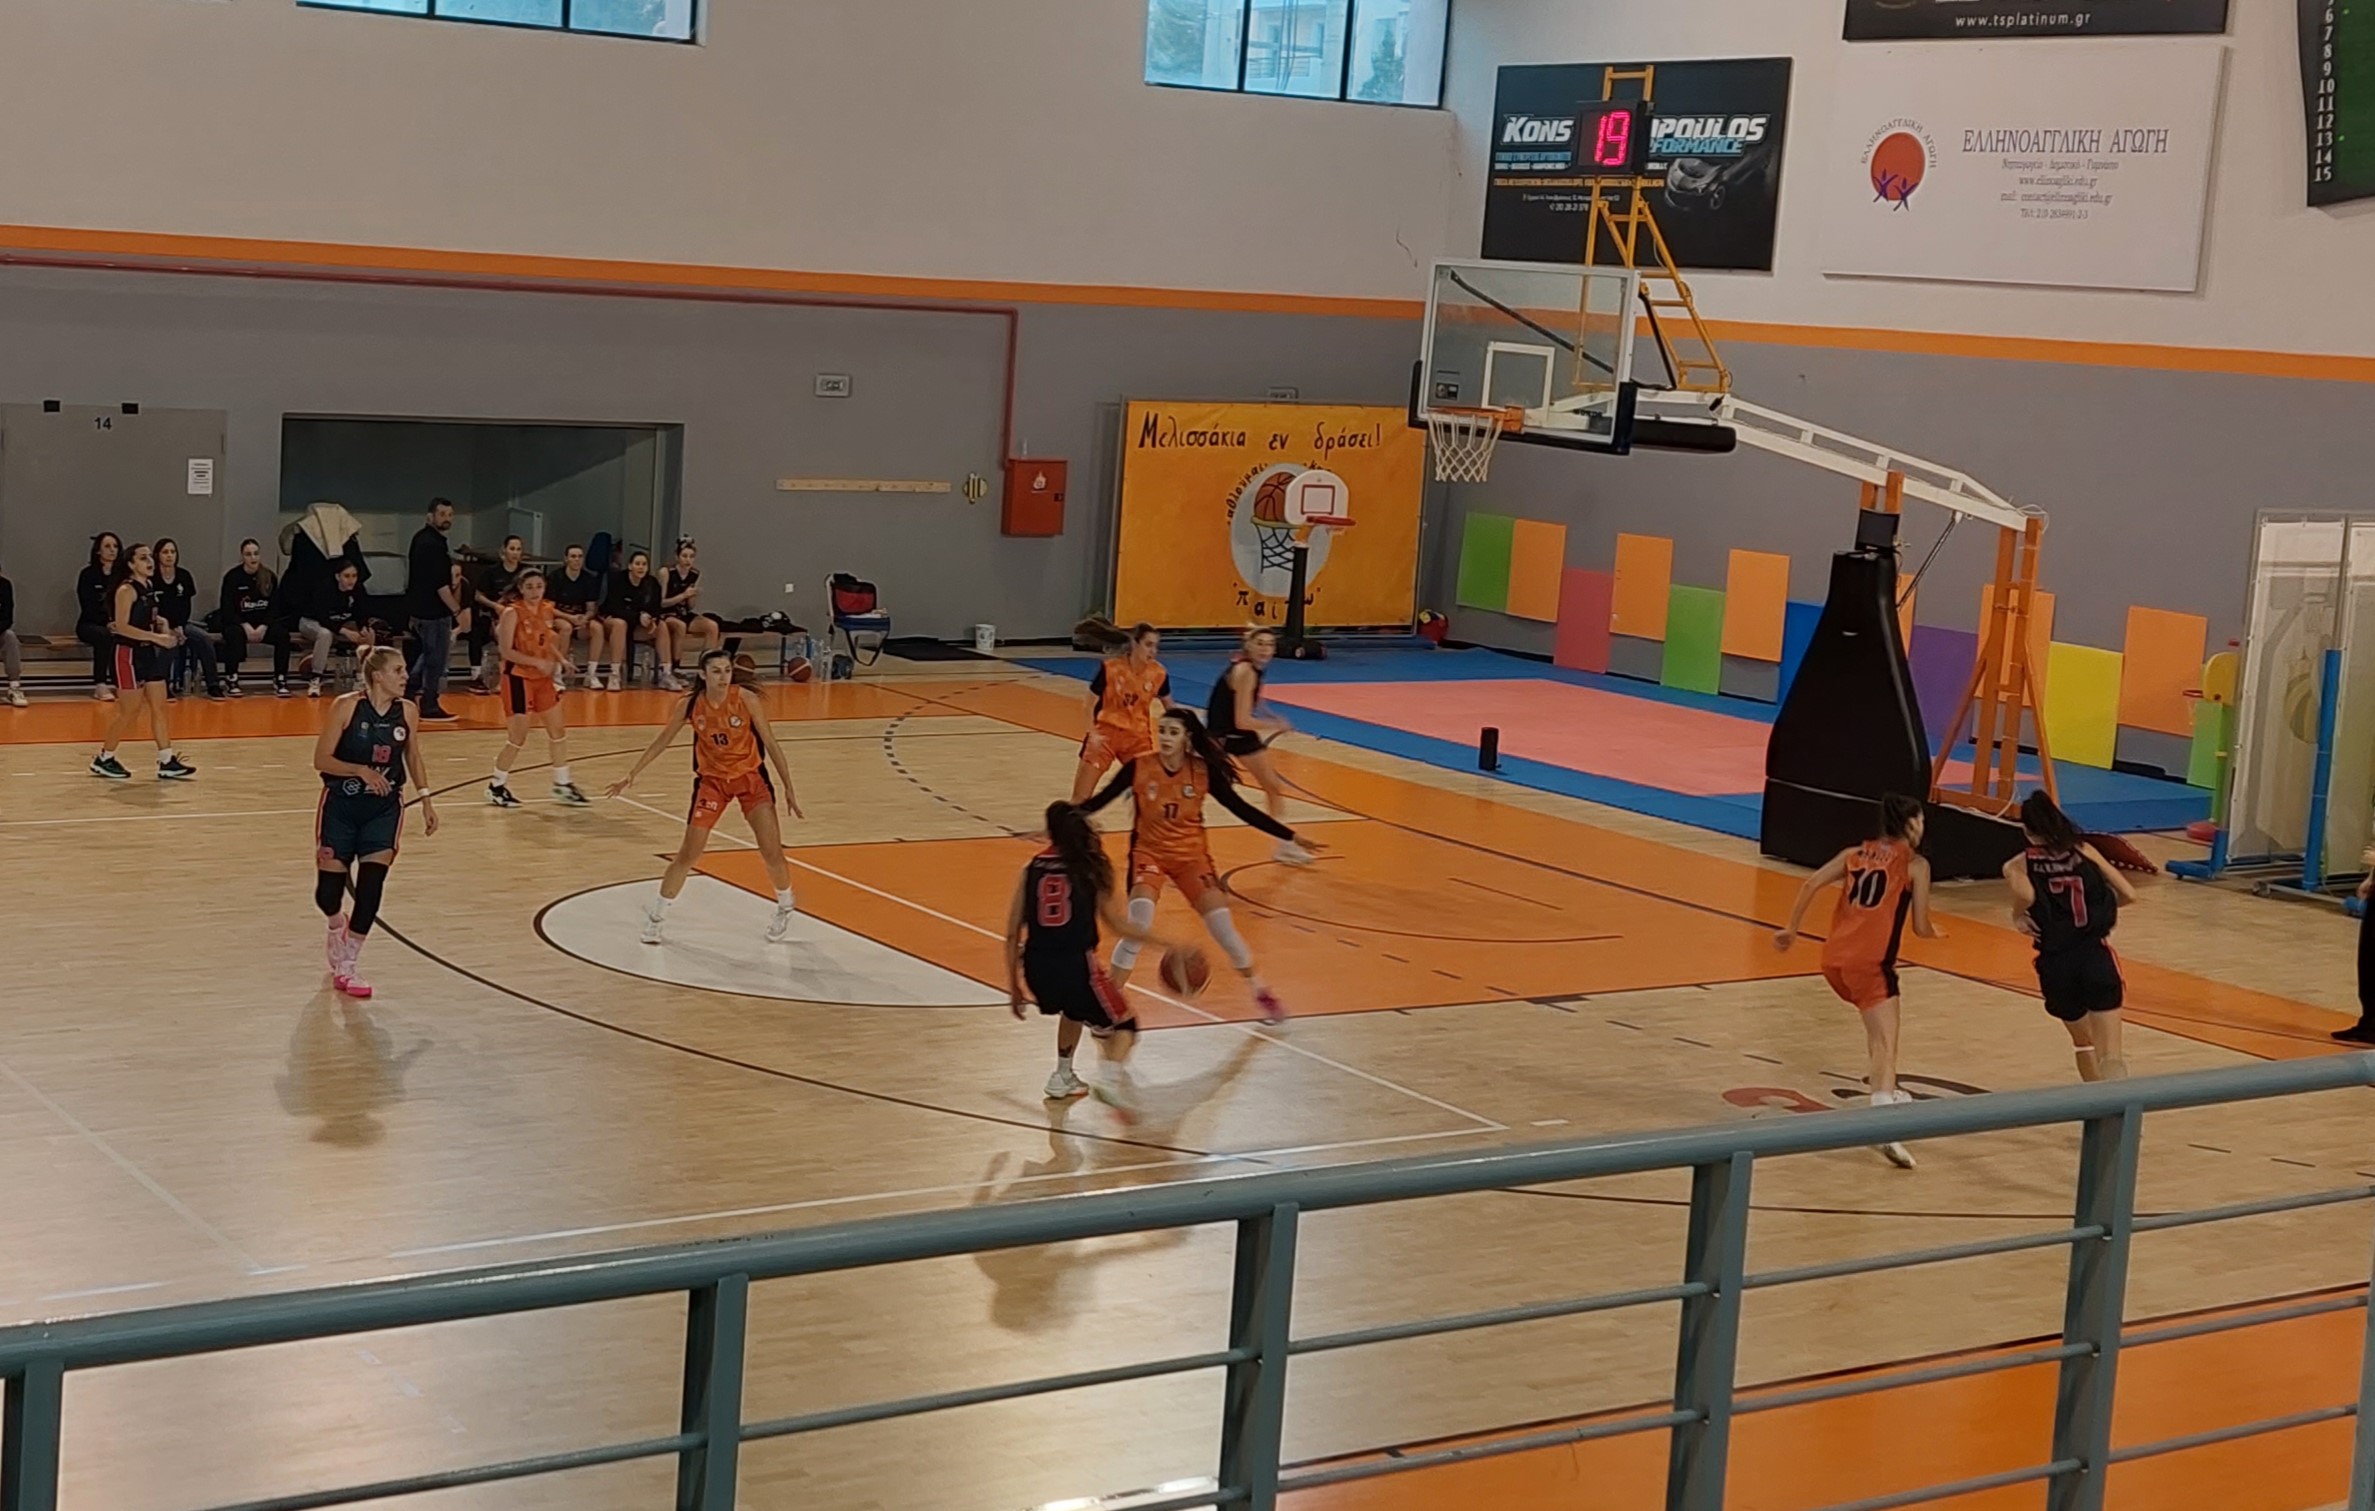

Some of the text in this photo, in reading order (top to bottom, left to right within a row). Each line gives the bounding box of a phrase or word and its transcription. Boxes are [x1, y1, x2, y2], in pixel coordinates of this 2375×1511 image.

[1955, 12, 2091, 28] www.tsplatinum.gr
[2324, 8, 2335, 24] 6
[2323, 25, 2334, 41] 7
[2323, 43, 2333, 59] 8
[2322, 60, 2333, 77] 9
[2317, 78, 2336, 94] 10
[2317, 95, 2334, 112] 11
[2316, 113, 2334, 130] 12
[1594, 108, 1631, 166] 19
[1962, 128, 2170, 153] ΕΛΛΗΝΟΑΓΓΛΙΚΗ ΑΓΩΓΗ
[2316, 131, 2333, 147] 13
[2315, 148, 2332, 165] 14
[2314, 166, 2332, 182] 15
[93, 416, 113, 430] 14
[1138, 410, 1381, 461] Μελισσάκια εν δράσει!
[710, 732, 730, 747] 13
[1161, 802, 1180, 820] 17
[1846, 867, 1890, 911] 10
[1036, 873, 1073, 928] 8
[2048, 875, 2089, 928] 7
